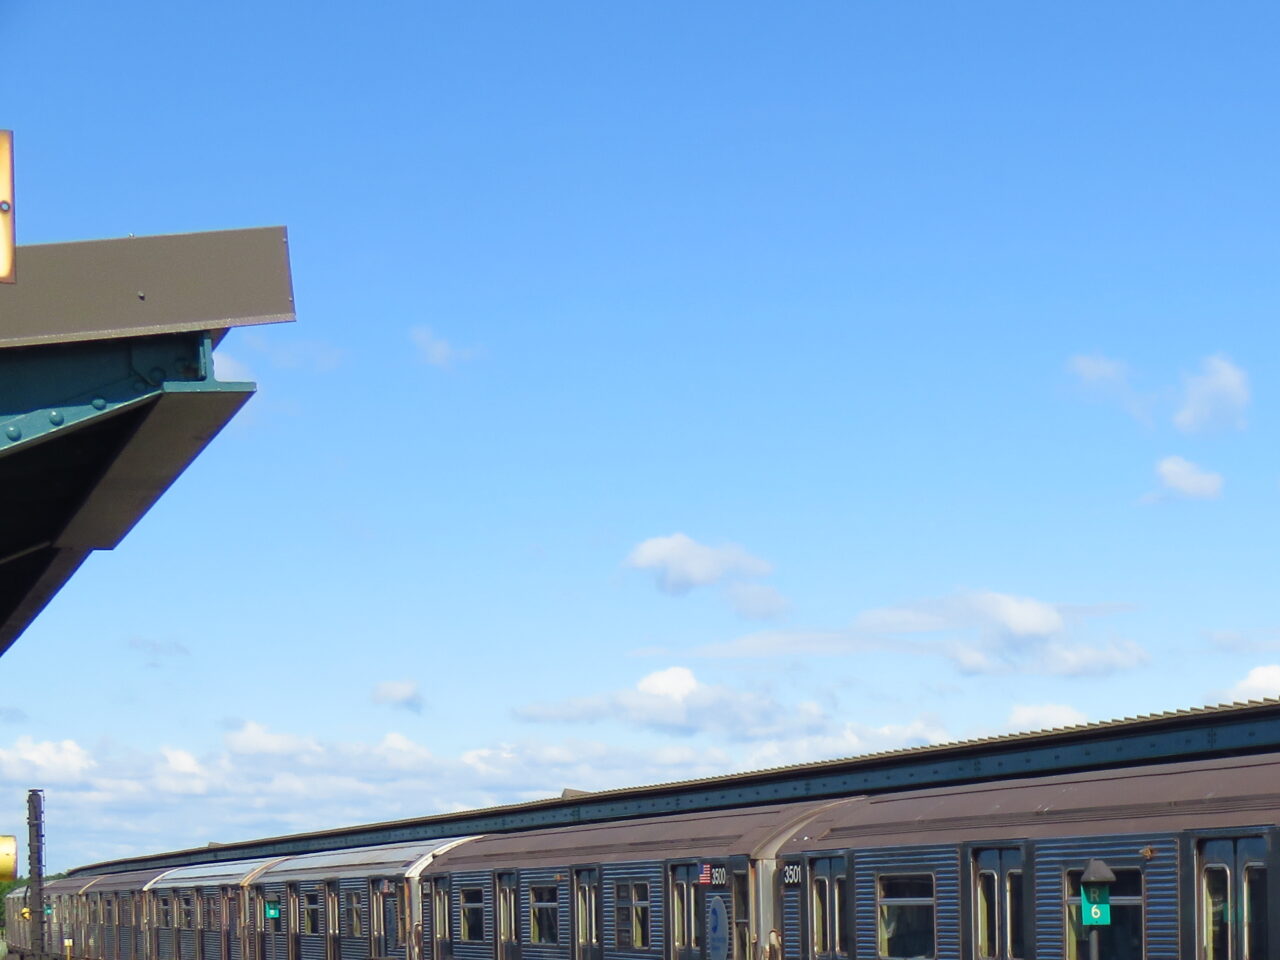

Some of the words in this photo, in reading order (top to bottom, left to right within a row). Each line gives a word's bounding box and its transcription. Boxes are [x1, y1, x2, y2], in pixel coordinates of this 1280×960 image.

[712, 867, 726, 885] 3500
[784, 865, 801, 884] 3501
[1090, 888, 1099, 902] R
[1091, 904, 1101, 918] 6
